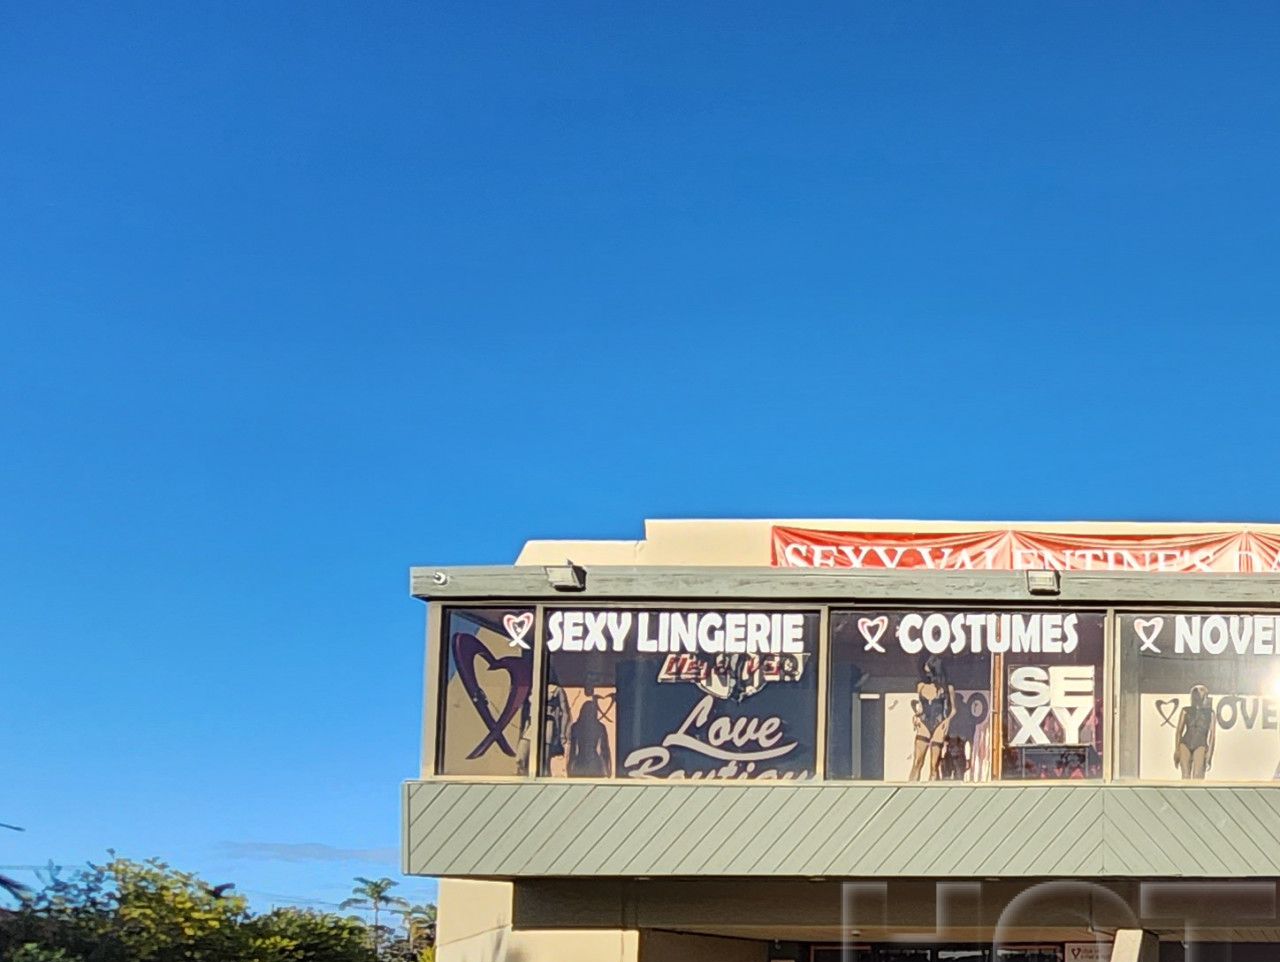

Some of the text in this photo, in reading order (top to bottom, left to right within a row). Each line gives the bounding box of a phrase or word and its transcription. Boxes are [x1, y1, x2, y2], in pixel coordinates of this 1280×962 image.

[784, 543, 900, 570] SEXY
[547, 612, 804, 653] SEXY LINGERIE
[899, 613, 1079, 654] COSTUMES
[662, 694, 799, 761] Love
